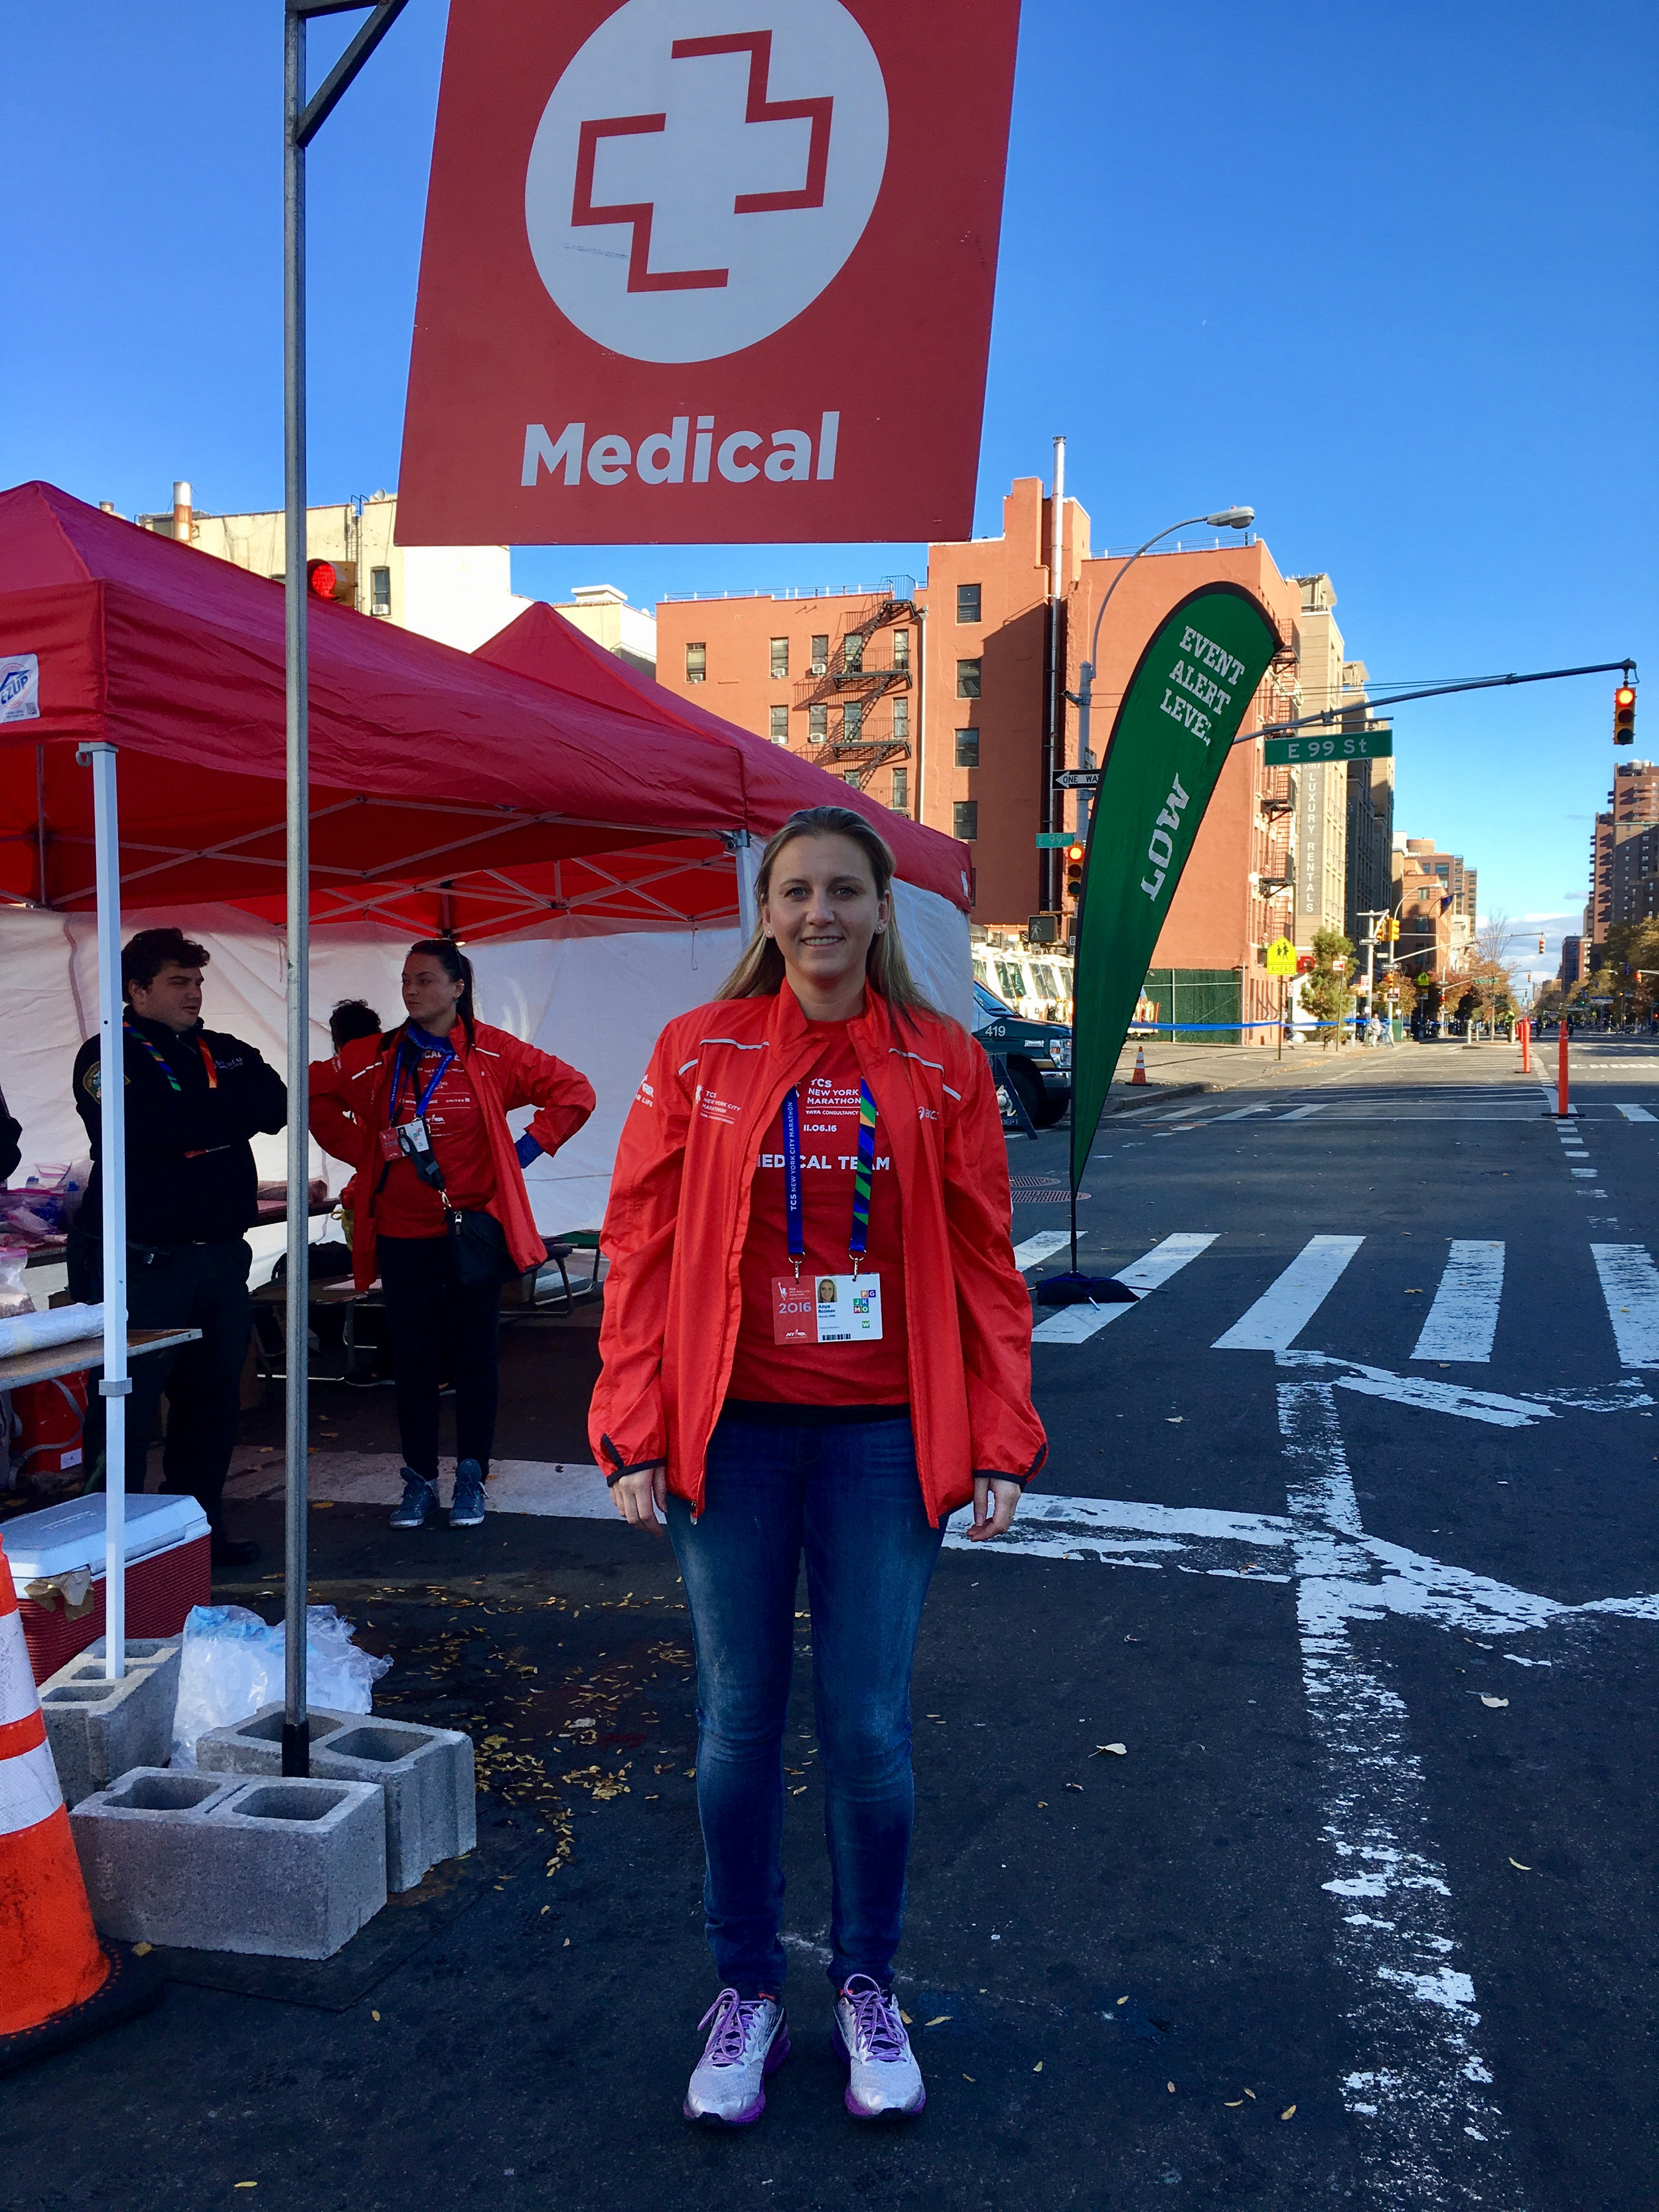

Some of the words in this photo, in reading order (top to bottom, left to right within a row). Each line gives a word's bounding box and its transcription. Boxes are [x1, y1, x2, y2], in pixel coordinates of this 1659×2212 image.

[521, 411, 839, 486] Medical
[1179, 625, 1245, 685] EVENT
[1169, 660, 1231, 715] ALERT
[1288, 743, 1299, 759] E
[1308, 741, 1334, 757] 99
[1343, 738, 1367, 754] St
[1063, 775, 1078, 784] ONE
[1307, 772, 1316, 834] LUXURY
[1039, 836, 1044, 846] E
[1048, 835, 1062, 846] 99
[1140, 773, 1189, 902] LOW
[1306, 842, 1315, 913] RENTALS
[985, 1025, 1006, 1037] 419
[810, 1078, 832, 1088] TCS
[808, 1088, 830, 1096] NEW
[642, 1097, 653, 1108] LIFE
[715, 1099, 727, 1108] YORK
[702, 1104, 727, 1114] MARATHON
[838, 1156, 890, 1170] TEM
[779, 1301, 812, 1313] 2016
